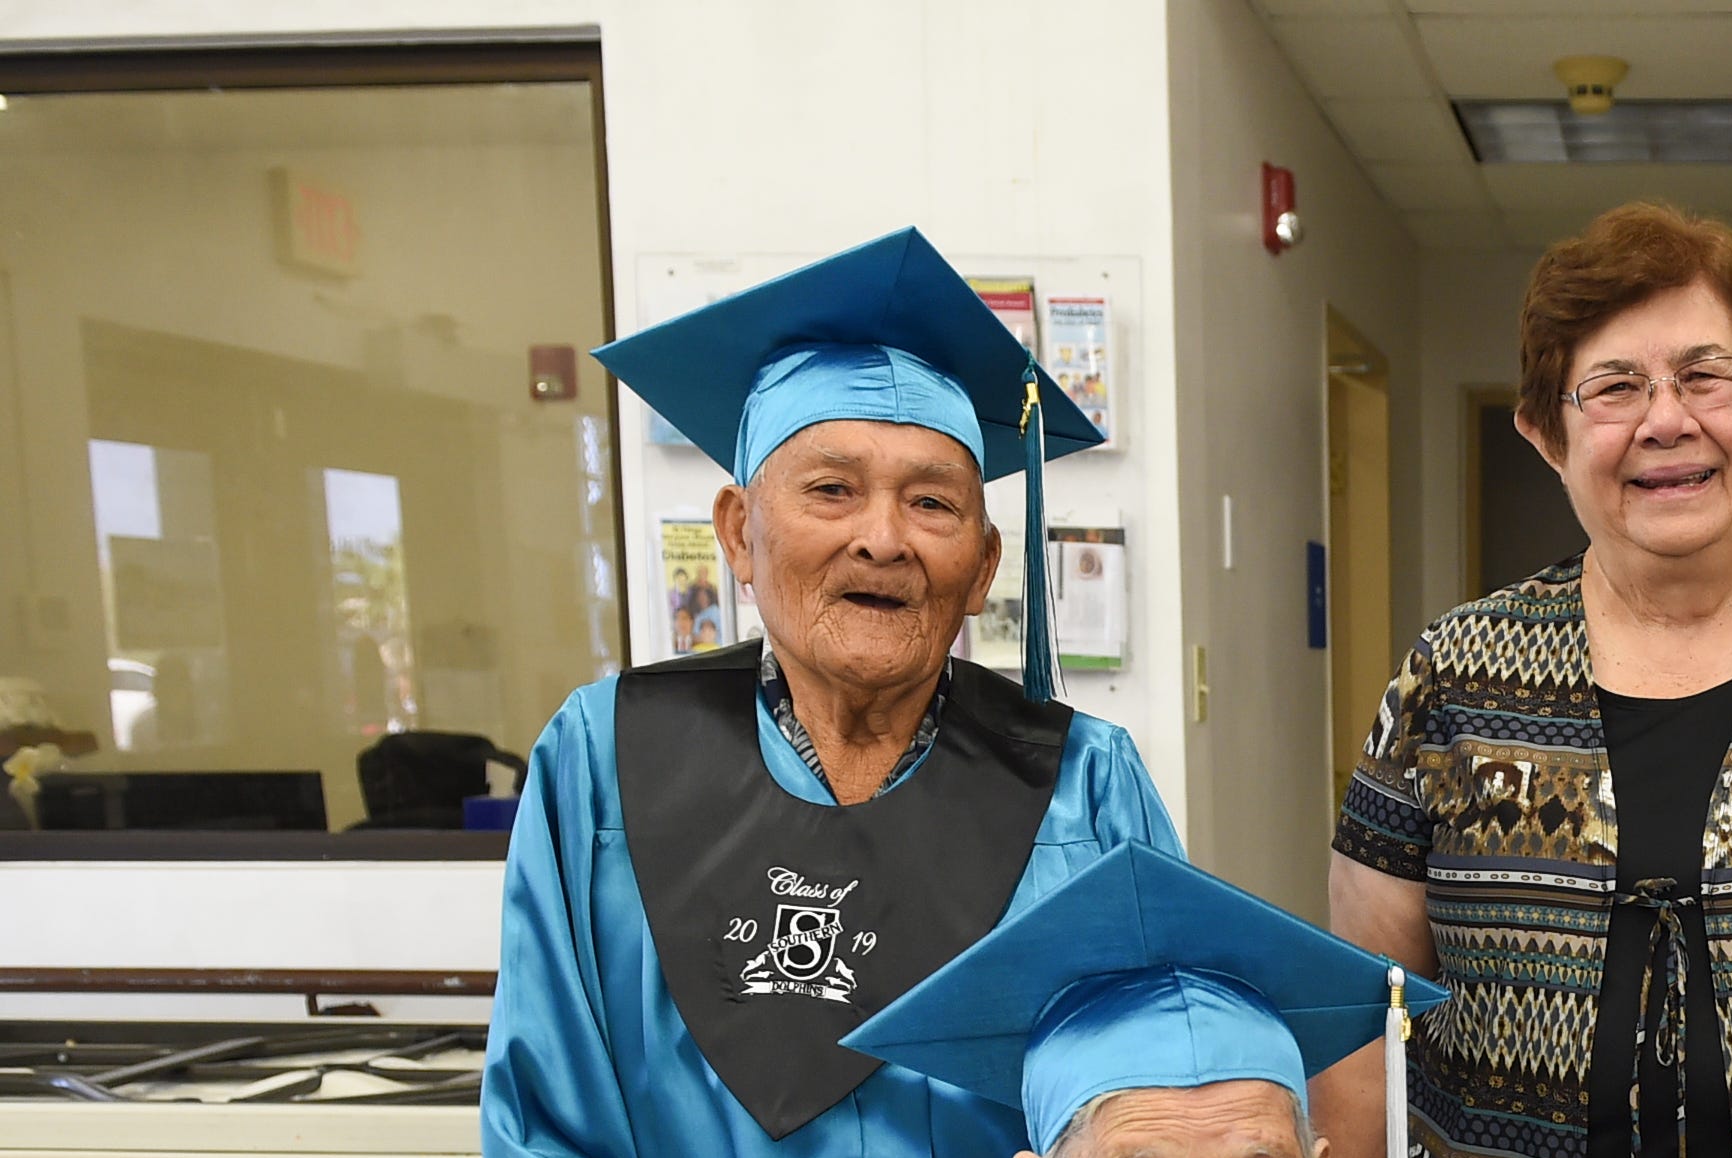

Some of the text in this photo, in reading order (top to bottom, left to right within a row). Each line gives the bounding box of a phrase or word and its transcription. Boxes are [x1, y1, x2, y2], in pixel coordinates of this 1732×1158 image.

[767, 867, 859, 907] Class of
[723, 917, 877, 955] 20 19
[770, 922, 842, 952] SOUTHERN
[783, 911, 826, 969] S
[772, 980, 825, 997] DOLPHINS
